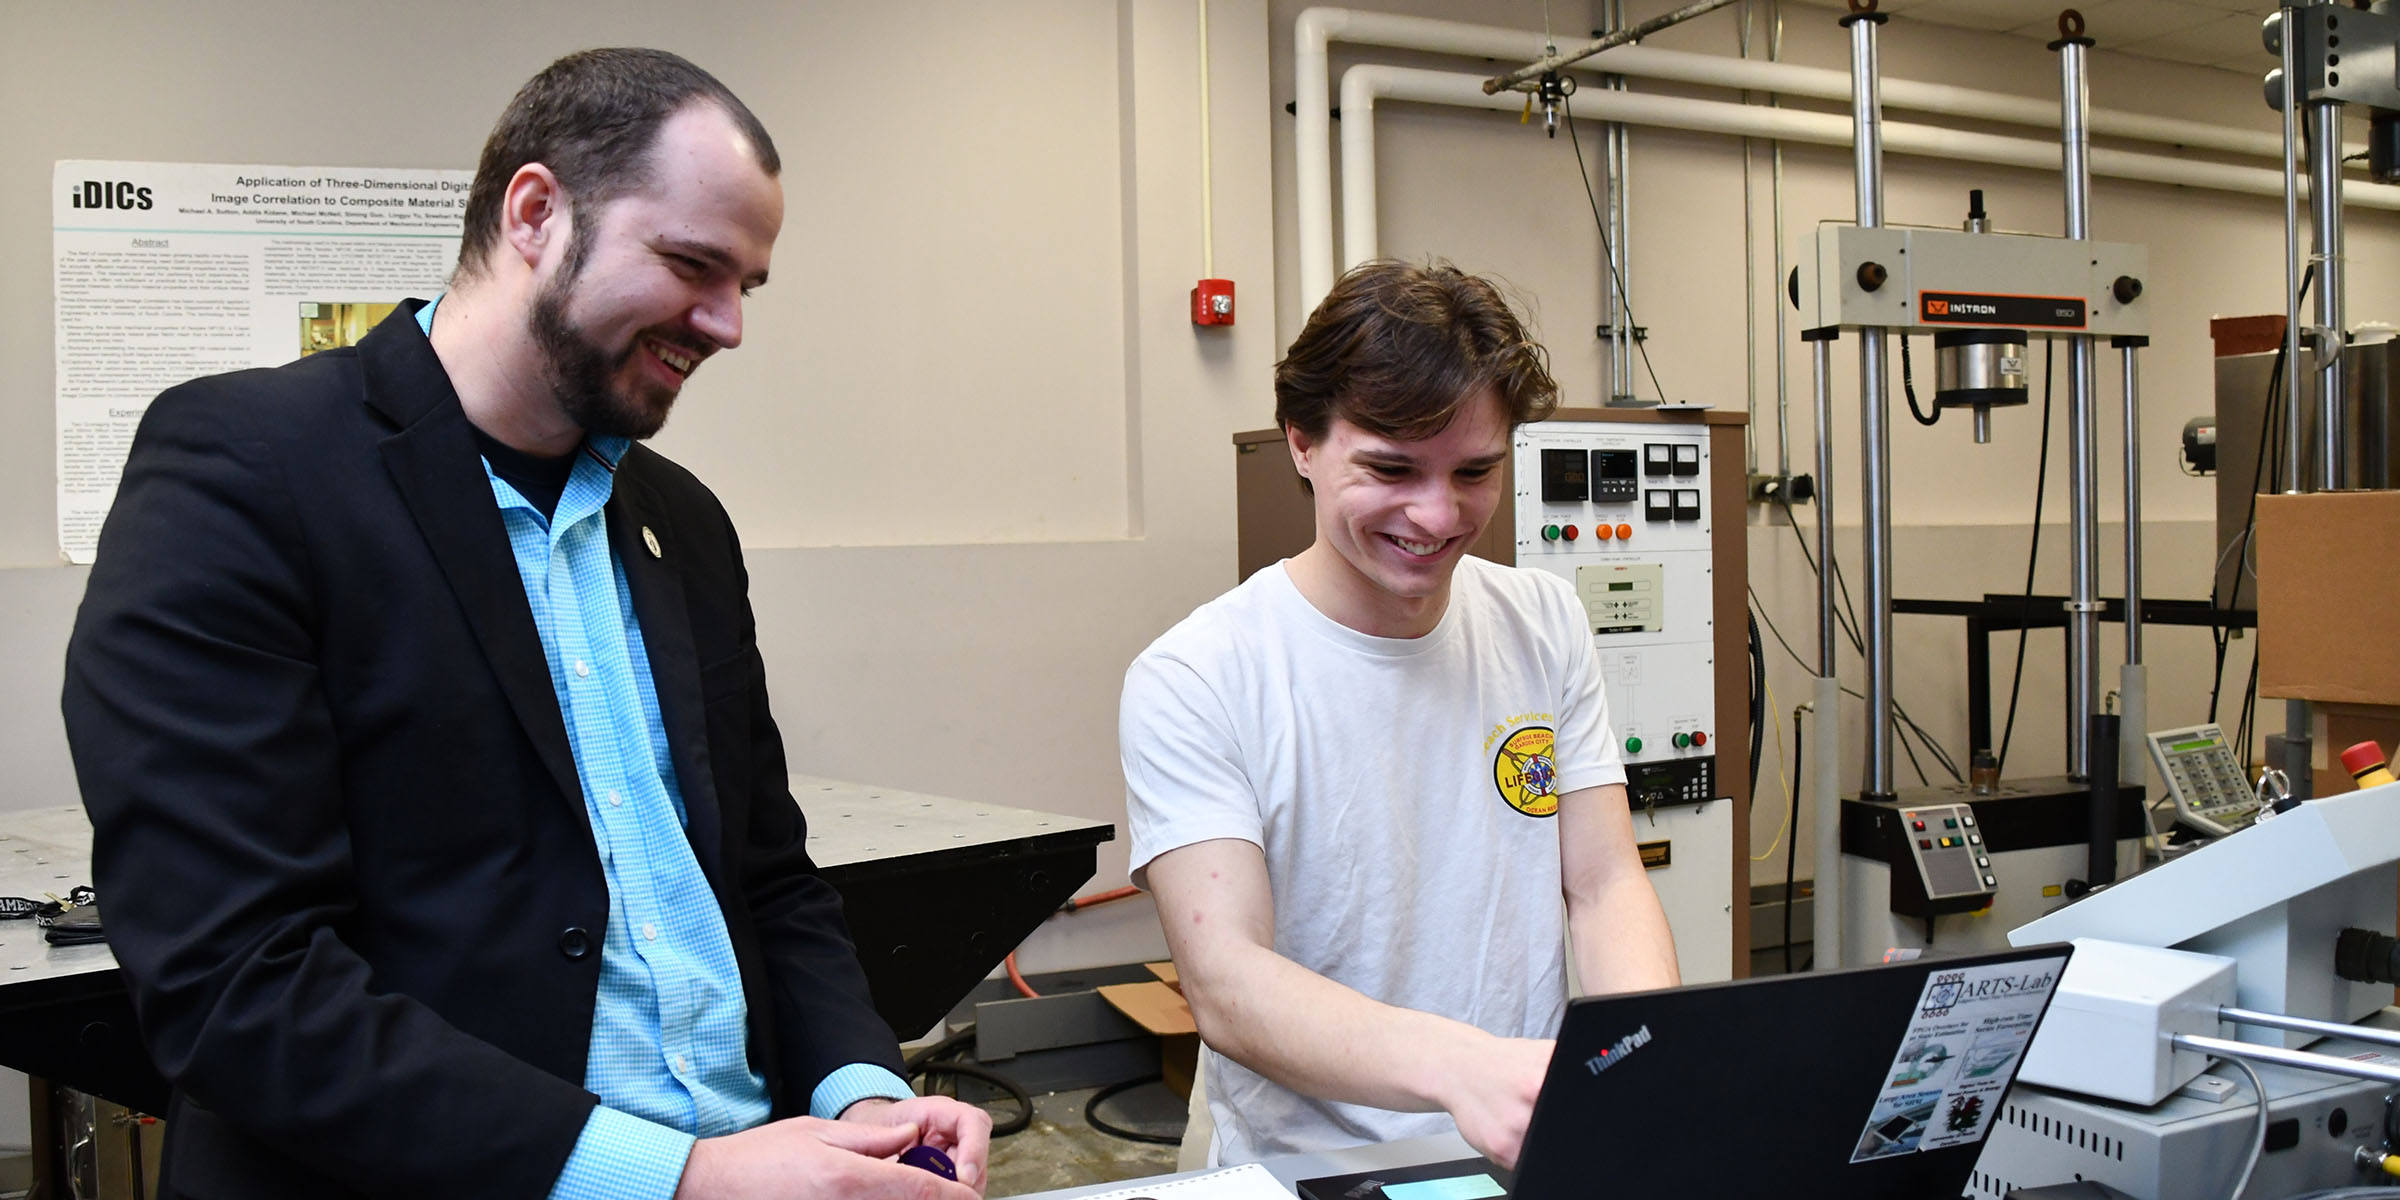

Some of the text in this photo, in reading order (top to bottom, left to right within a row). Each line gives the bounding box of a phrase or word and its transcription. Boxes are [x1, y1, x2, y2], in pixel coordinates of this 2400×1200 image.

[236, 176, 306, 188] Application
[310, 178, 322, 188] of
[326, 179, 438, 190] Three-Dimensional
[73, 181, 153, 210] iDICs
[211, 194, 248, 206] Image
[252, 194, 320, 204] Correlation
[324, 197, 336, 206] to
[340, 196, 404, 209] Composite
[408, 198, 454, 208] Material
[132, 238, 169, 248] Abstract
[1950, 303, 1996, 315] INSTRON
[1960, 972, 2052, 998] ARTS-Lab
[1584, 1024, 1652, 1075] ThinkPad
